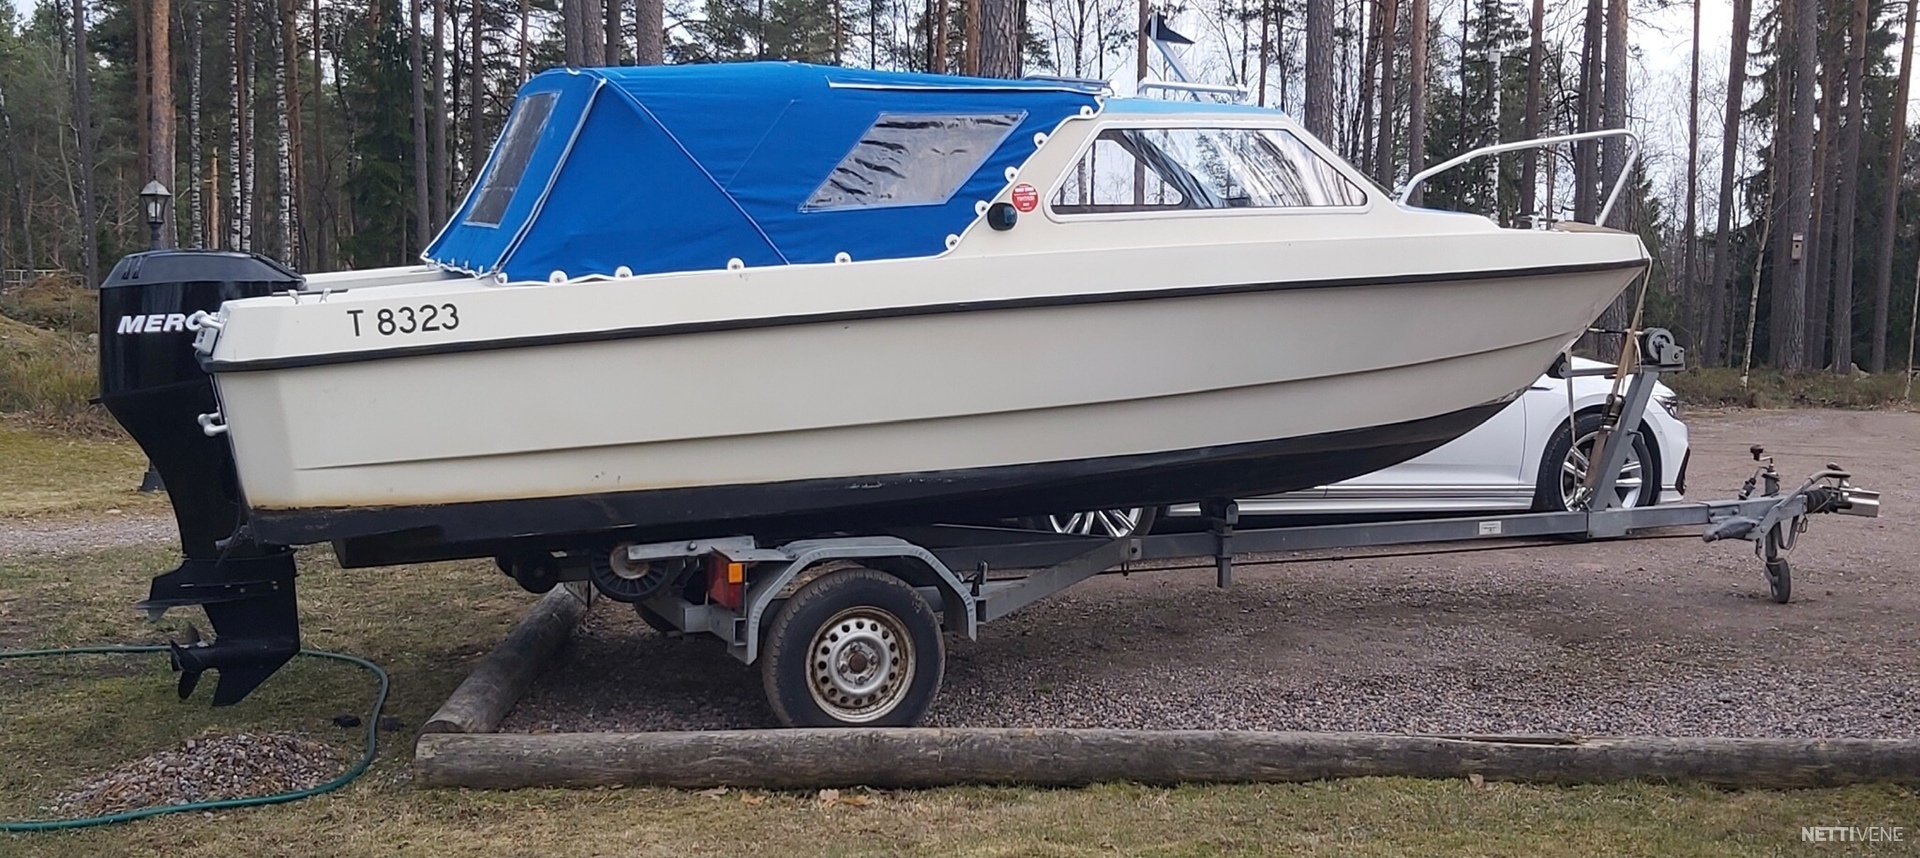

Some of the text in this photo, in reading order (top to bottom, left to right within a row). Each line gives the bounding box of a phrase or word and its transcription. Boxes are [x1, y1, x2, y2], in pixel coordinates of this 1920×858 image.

[117, 312, 220, 334] MERC
[346, 303, 460, 337] T 8323
